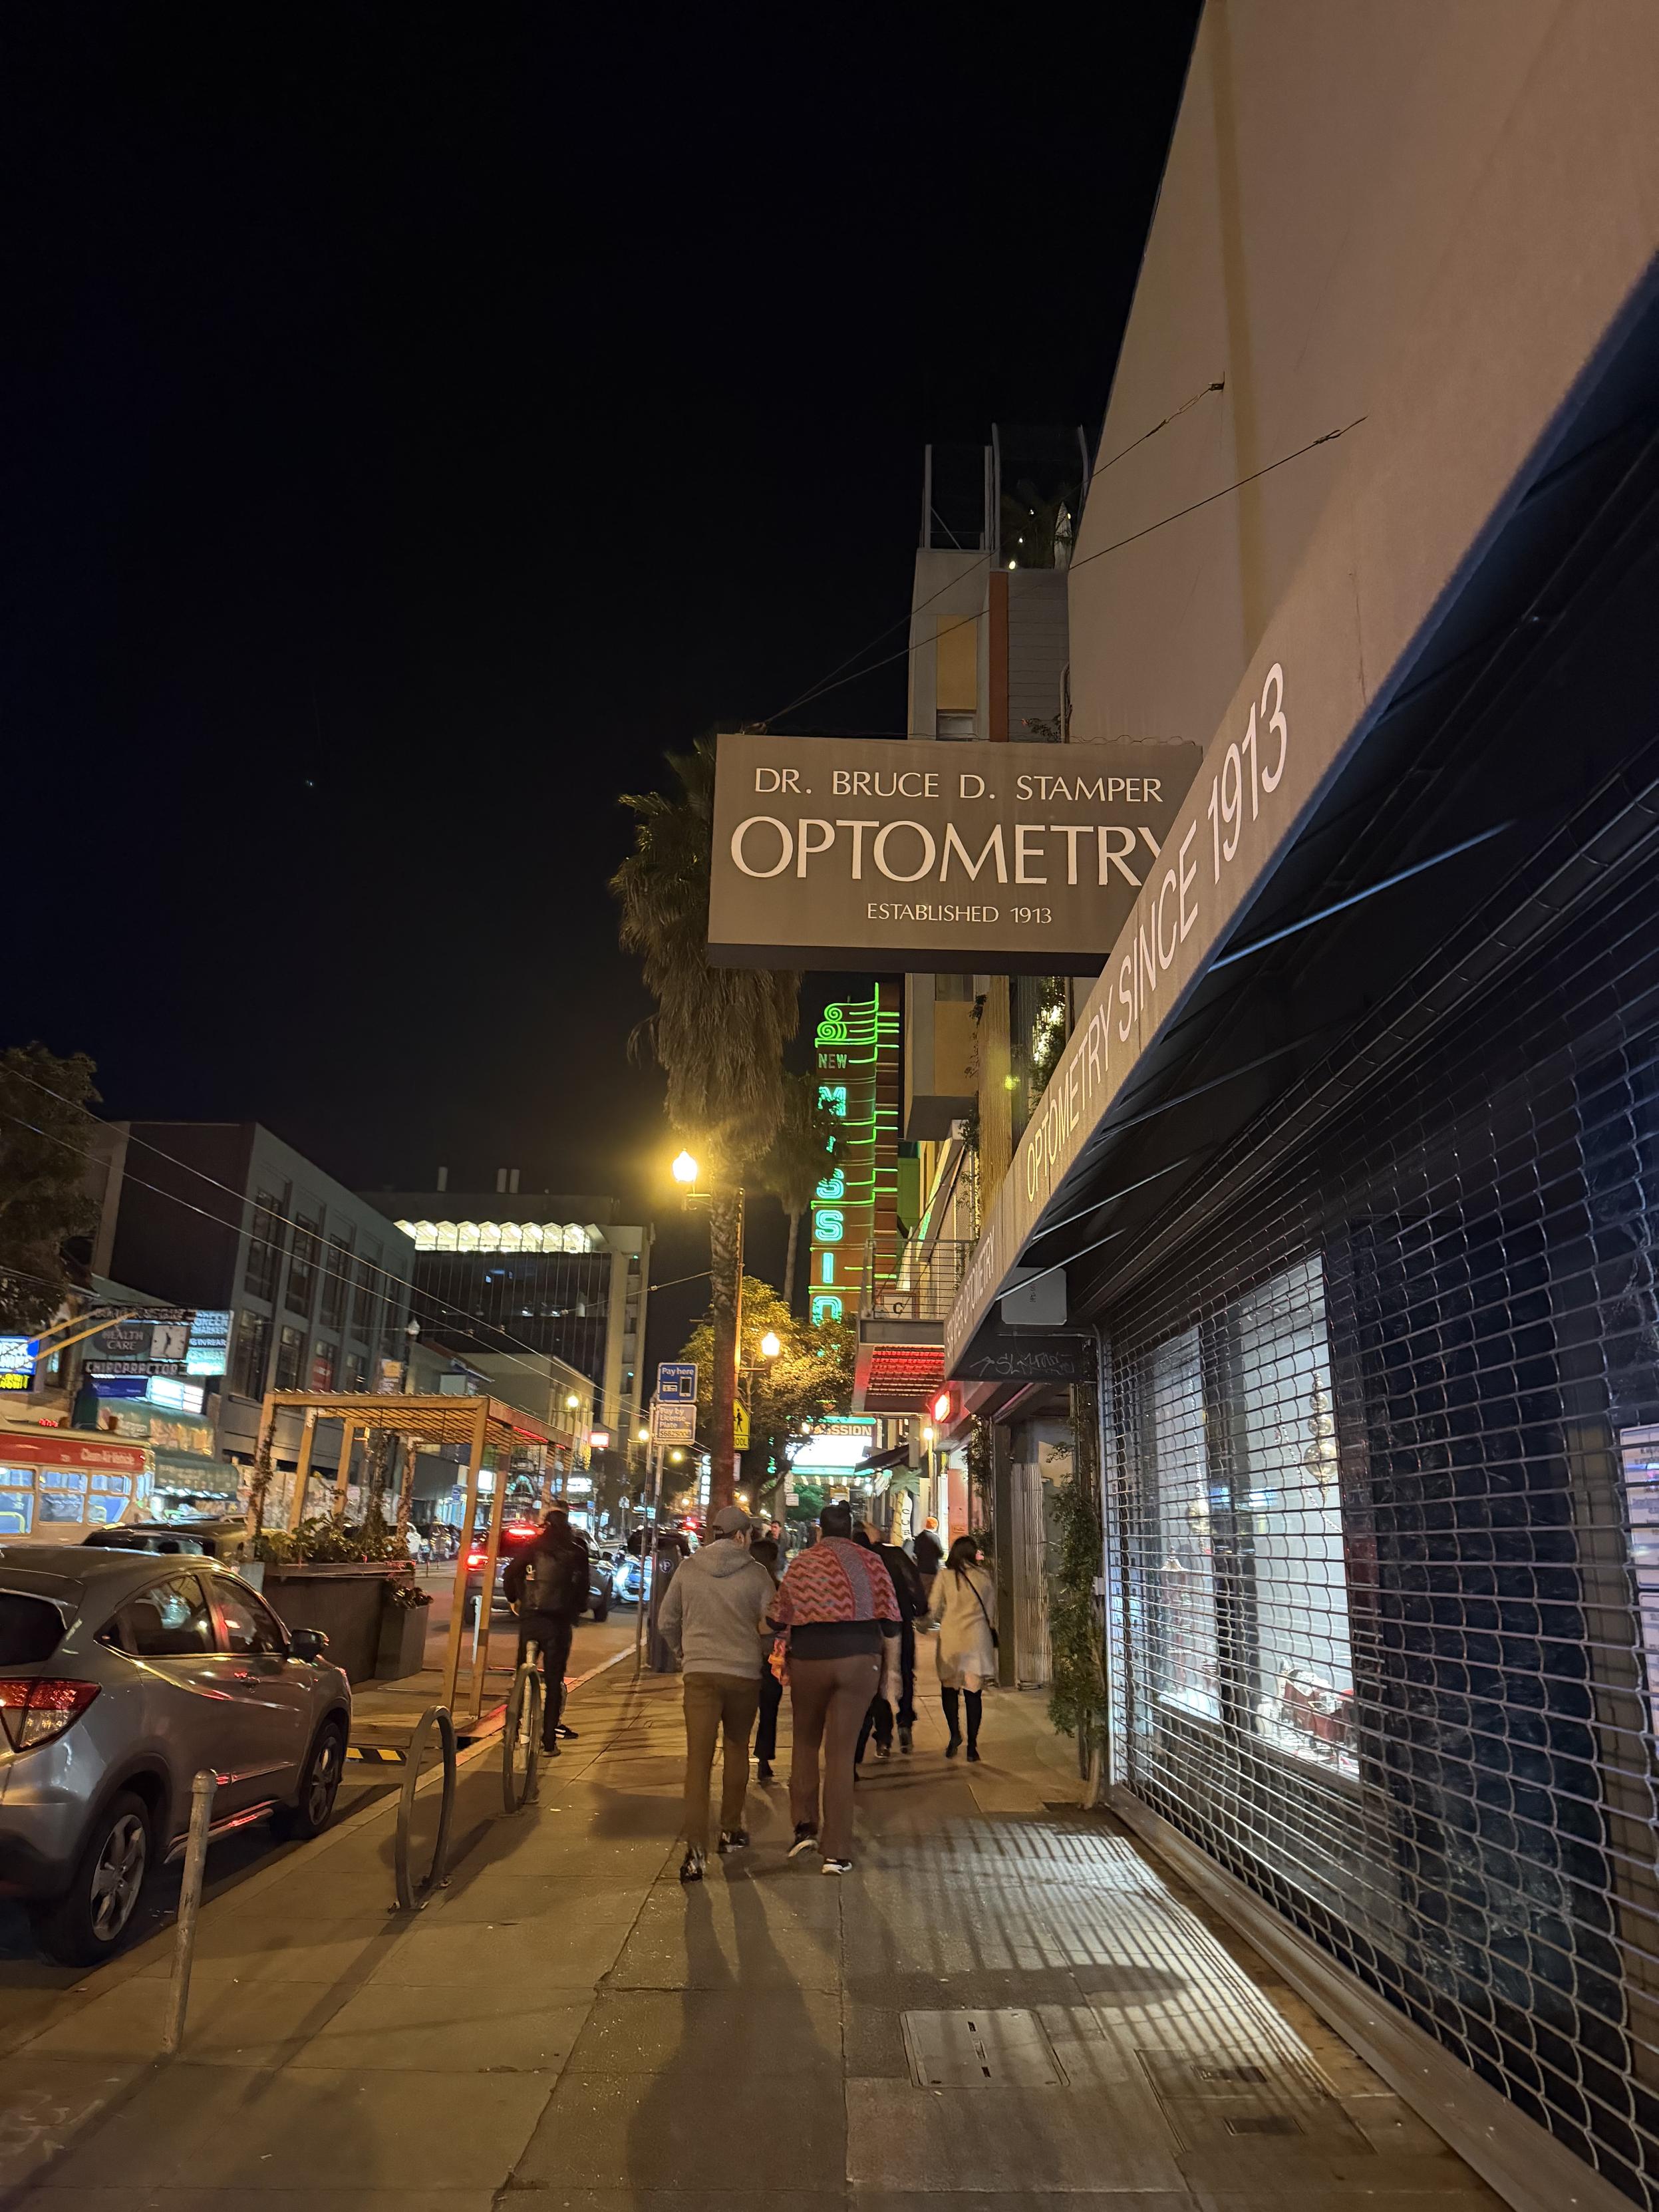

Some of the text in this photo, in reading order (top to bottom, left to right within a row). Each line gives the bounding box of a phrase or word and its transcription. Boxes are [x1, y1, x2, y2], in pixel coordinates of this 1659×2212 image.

[755, 768, 1163, 803] DR. BRUCE D. STAMPER
[1118, 663, 1287, 1042] SINCE 1913
[867, 903, 1052, 925] ESTABLISHED 1913
[818, 1053, 847, 1069] NEW
[1027, 984, 1113, 1202] OPTOMETRY
[812, 1086, 847, 1328] MSSIO
[102, 1330, 144, 1341] HEALTH
[107, 1340, 136, 1350] CARE
[85, 1362, 178, 1375] CHIROPRACTOR
[662, 1367, 675, 1376] Pay
[660, 1407, 684, 1417] Pay by
[660, 1414, 686, 1422] License
